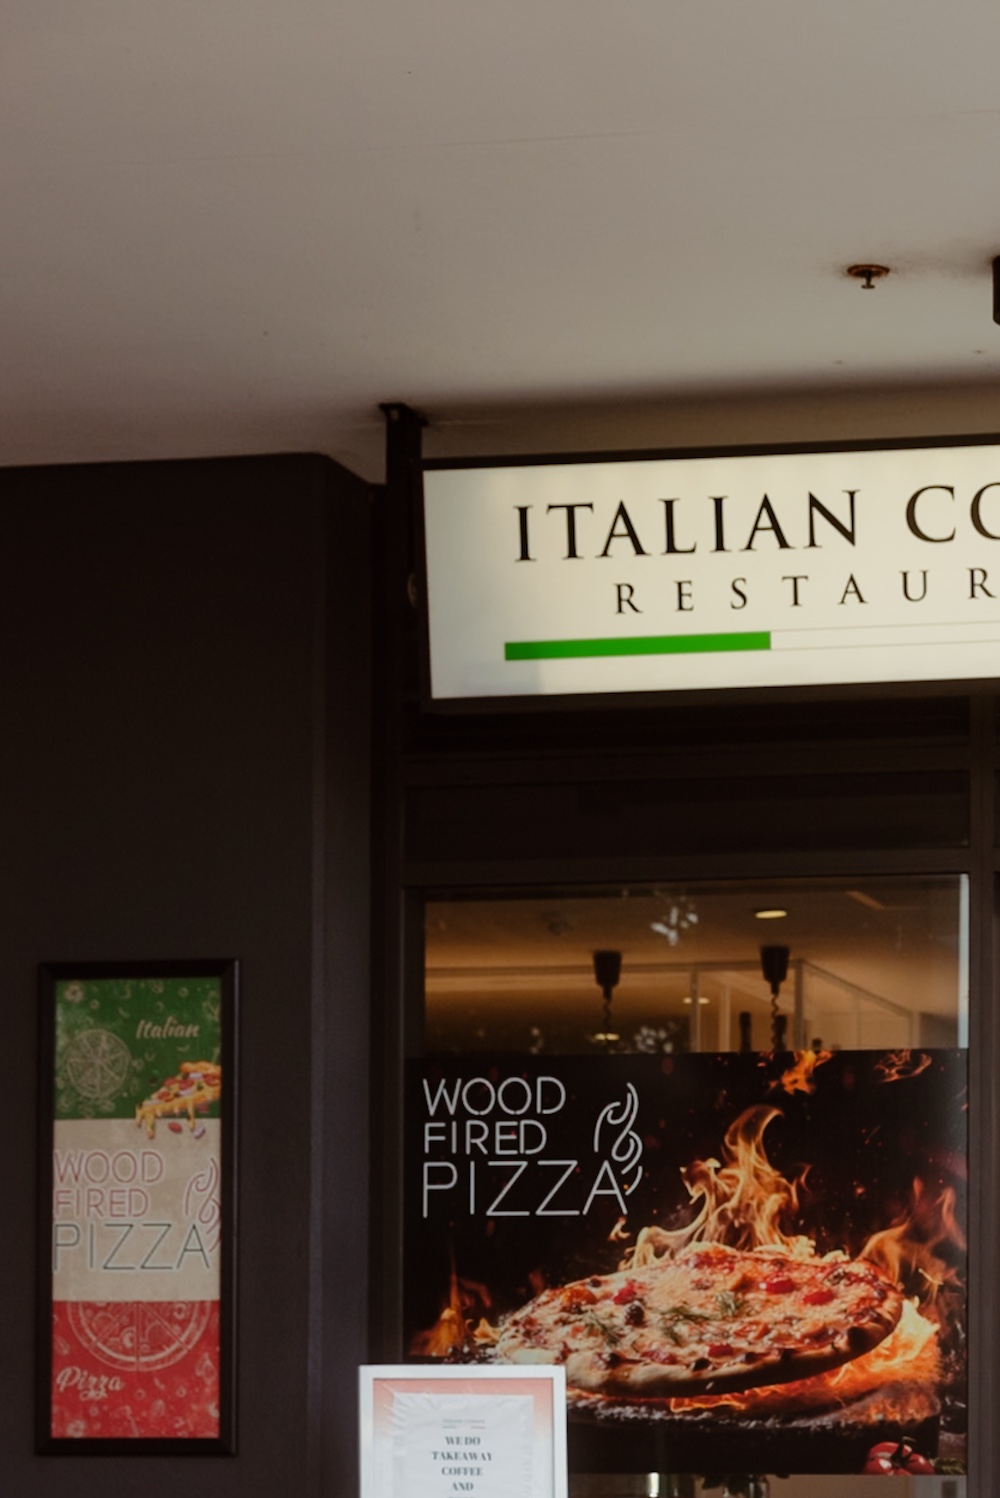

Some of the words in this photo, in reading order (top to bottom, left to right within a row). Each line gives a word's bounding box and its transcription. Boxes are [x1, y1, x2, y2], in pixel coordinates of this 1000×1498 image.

[511, 488, 860, 563] ITALIAN
[135, 1015, 201, 1039] Italian
[422, 1076, 567, 1116] WOOD
[424, 1119, 548, 1155] FIRED
[54, 1150, 165, 1185] WOOD
[54, 1188, 151, 1218] FIRED
[422, 1159, 629, 1219] PIZZA
[53, 1222, 212, 1272] PIZZA
[55, 1364, 126, 1402] Pizza
[431, 1451, 493, 1461] TAKEAWAY
[445, 1436, 463, 1446] WE
[464, 1436, 481, 1446] DO
[441, 1467, 483, 1477] COFFEE
[451, 1481, 475, 1492] AND
